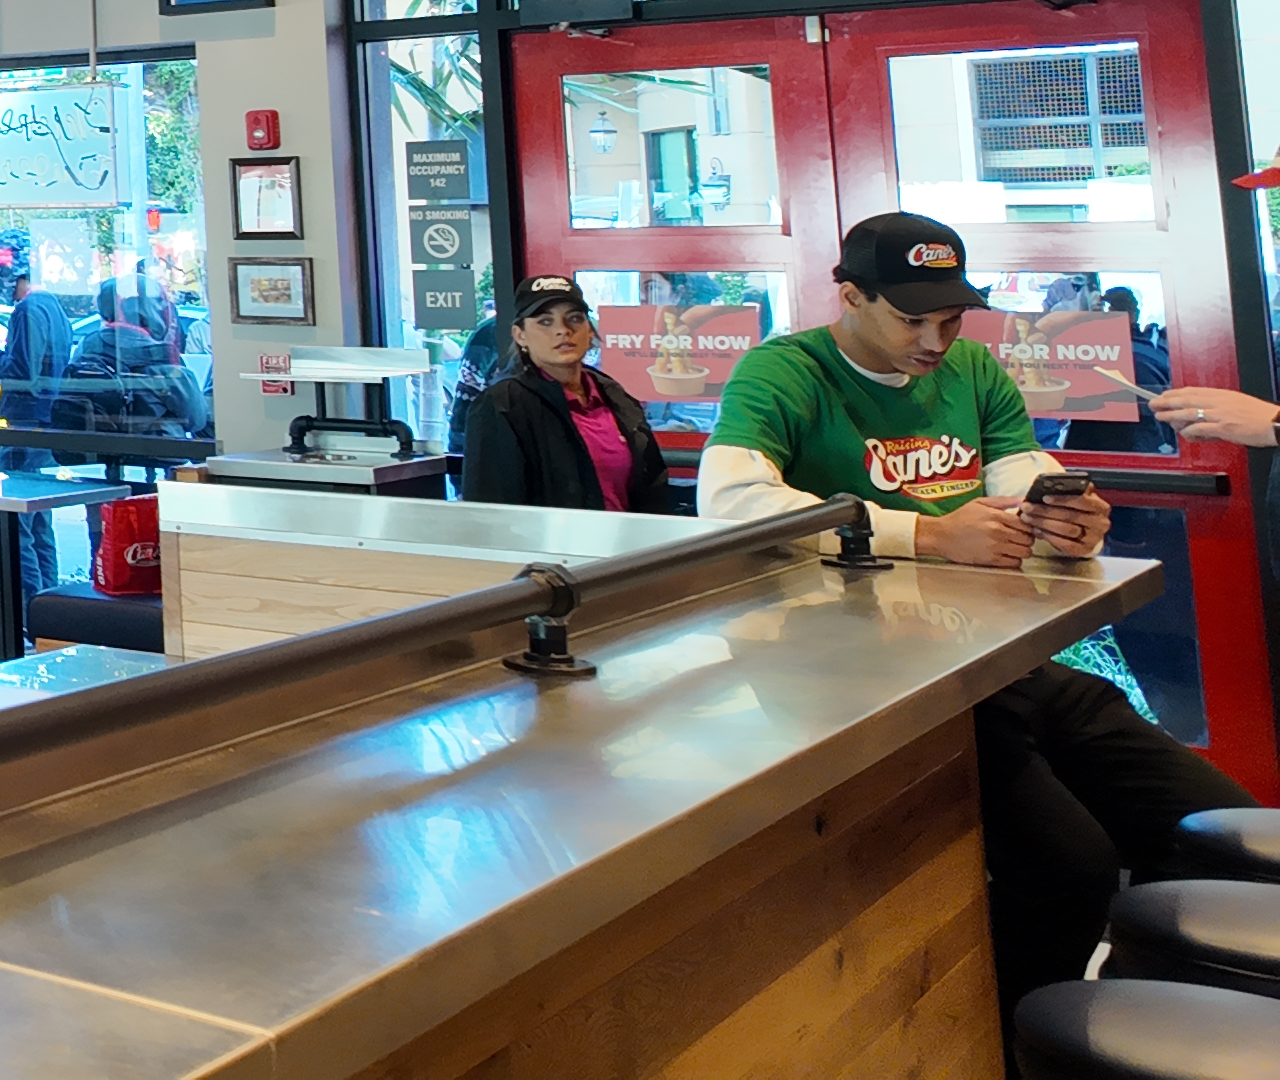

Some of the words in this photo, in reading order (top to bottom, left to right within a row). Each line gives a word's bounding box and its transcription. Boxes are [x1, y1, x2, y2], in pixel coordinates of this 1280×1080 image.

[412, 152, 461, 163] MAXIMUM
[409, 164, 467, 176] OCCUPANCY
[429, 177, 447, 188] 142
[409, 210, 424, 221] NO
[425, 210, 470, 221] SMOKING
[425, 291, 463, 309] EXIT
[605, 334, 645, 349] FRY
[649, 334, 693, 350] FOR
[698, 335, 751, 351] NOW
[998, 343, 1050, 360] FOR
[1056, 344, 1122, 362] NOW
[262, 356, 285, 366] FIRE
[1019, 362, 1040, 370] YOU
[1042, 362, 1069, 370] NEXT
[885, 439, 931, 453] Raising
[864, 434, 977, 491] Cane's
